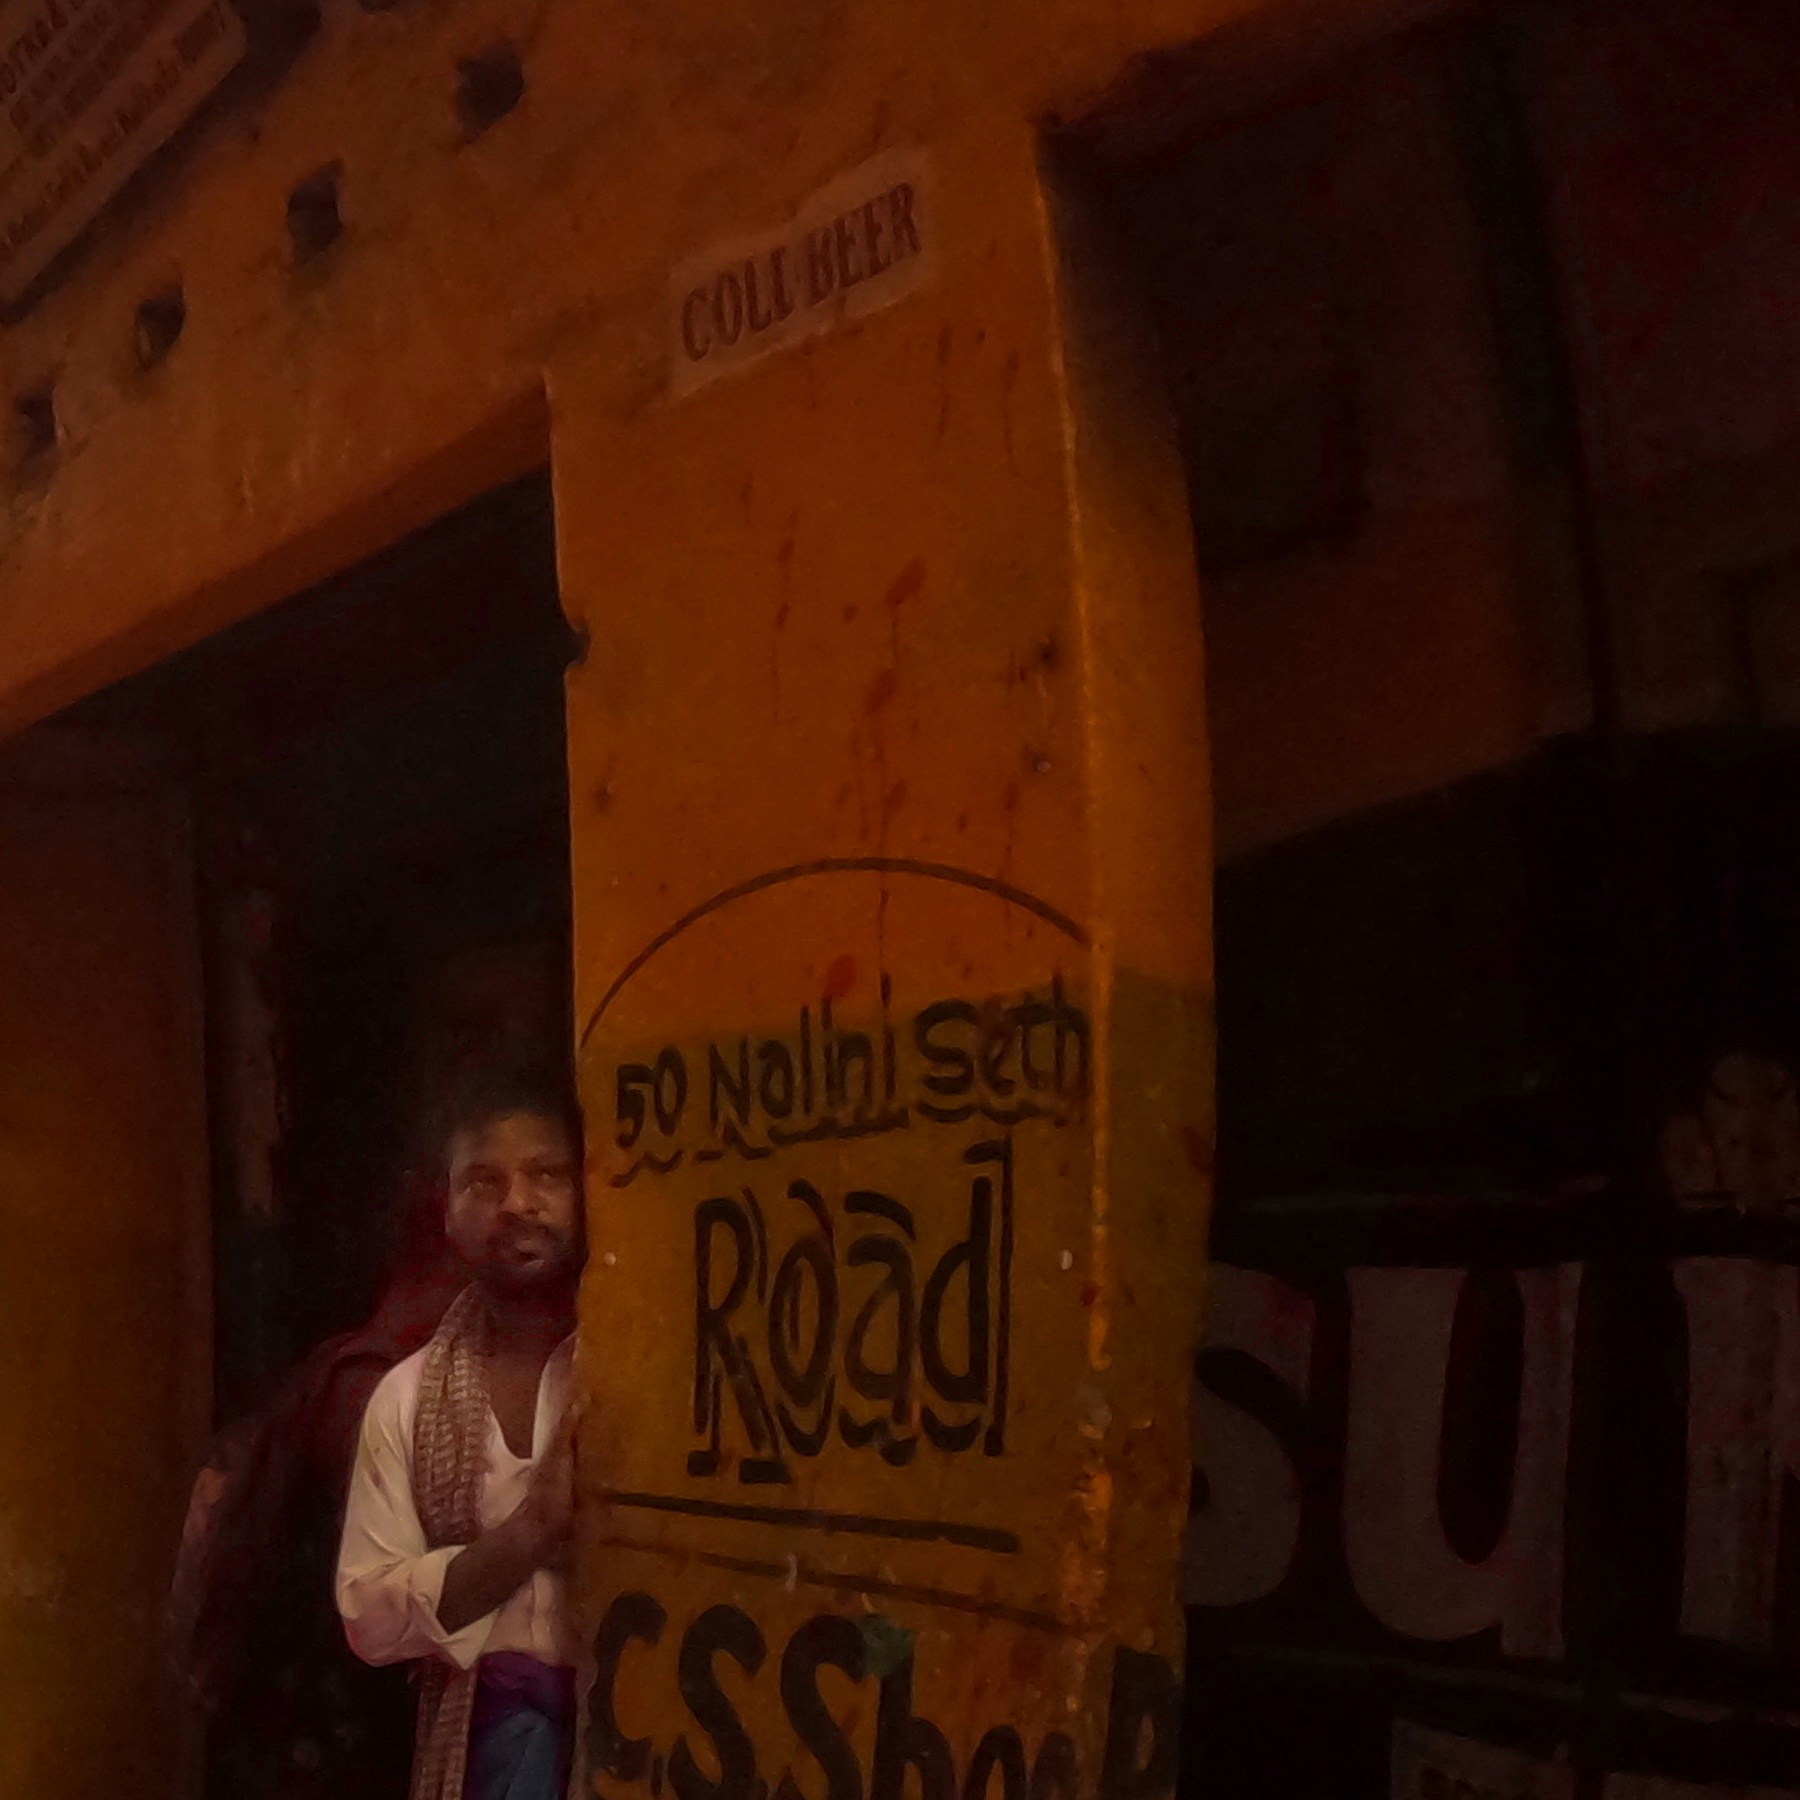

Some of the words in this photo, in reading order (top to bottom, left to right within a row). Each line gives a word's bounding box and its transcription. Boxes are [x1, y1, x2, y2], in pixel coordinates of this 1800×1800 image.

[805, 181, 921, 308] BEER
[614, 1044, 688, 1148] 50
[707, 972, 900, 1128] Nalini
[912, 972, 1092, 1118] Seth
[689, 1140, 1012, 1476] Road
